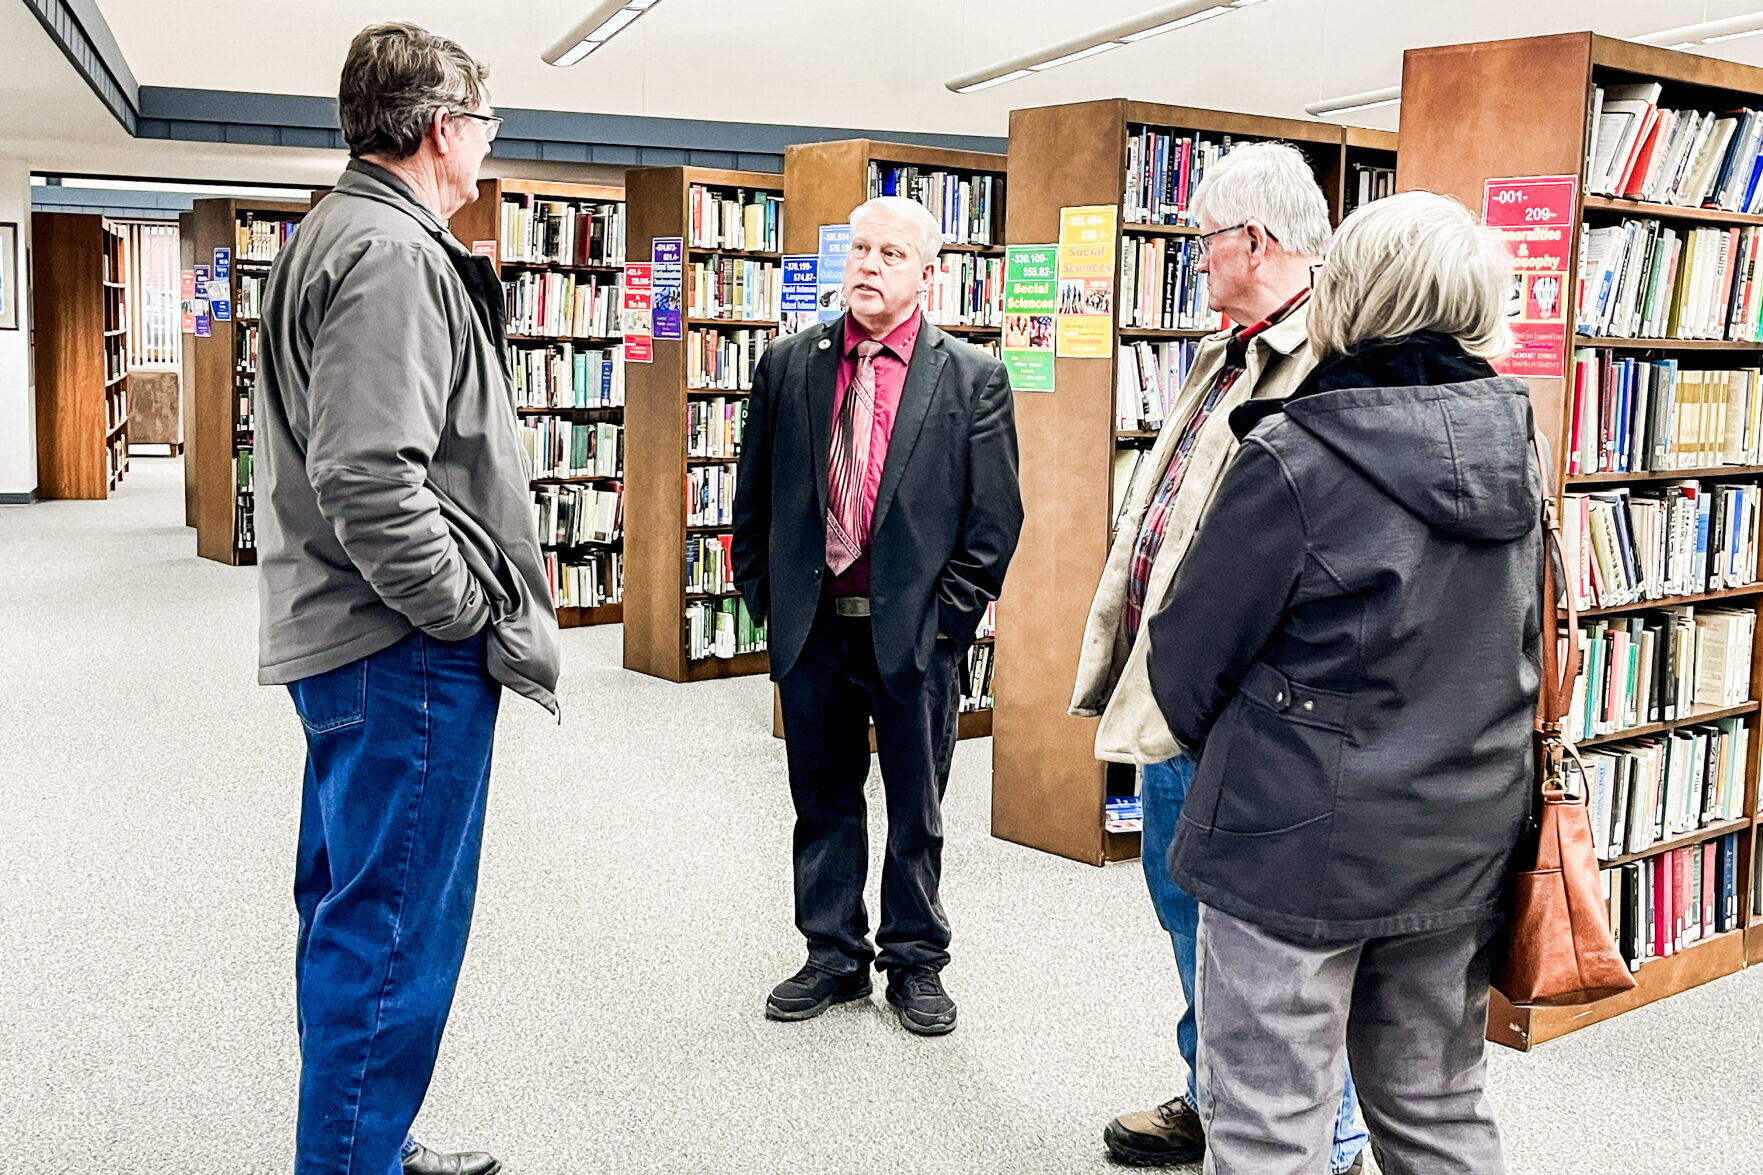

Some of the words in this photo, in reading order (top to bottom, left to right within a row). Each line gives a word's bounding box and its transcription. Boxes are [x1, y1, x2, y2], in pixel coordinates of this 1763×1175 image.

[1525, 208, 1557, 221] 209-
[1068, 245, 1105, 258] Social
[1063, 262, 1112, 274] Sciences
[1013, 282, 1049, 294] Social
[1007, 297, 1054, 309] Sciences
